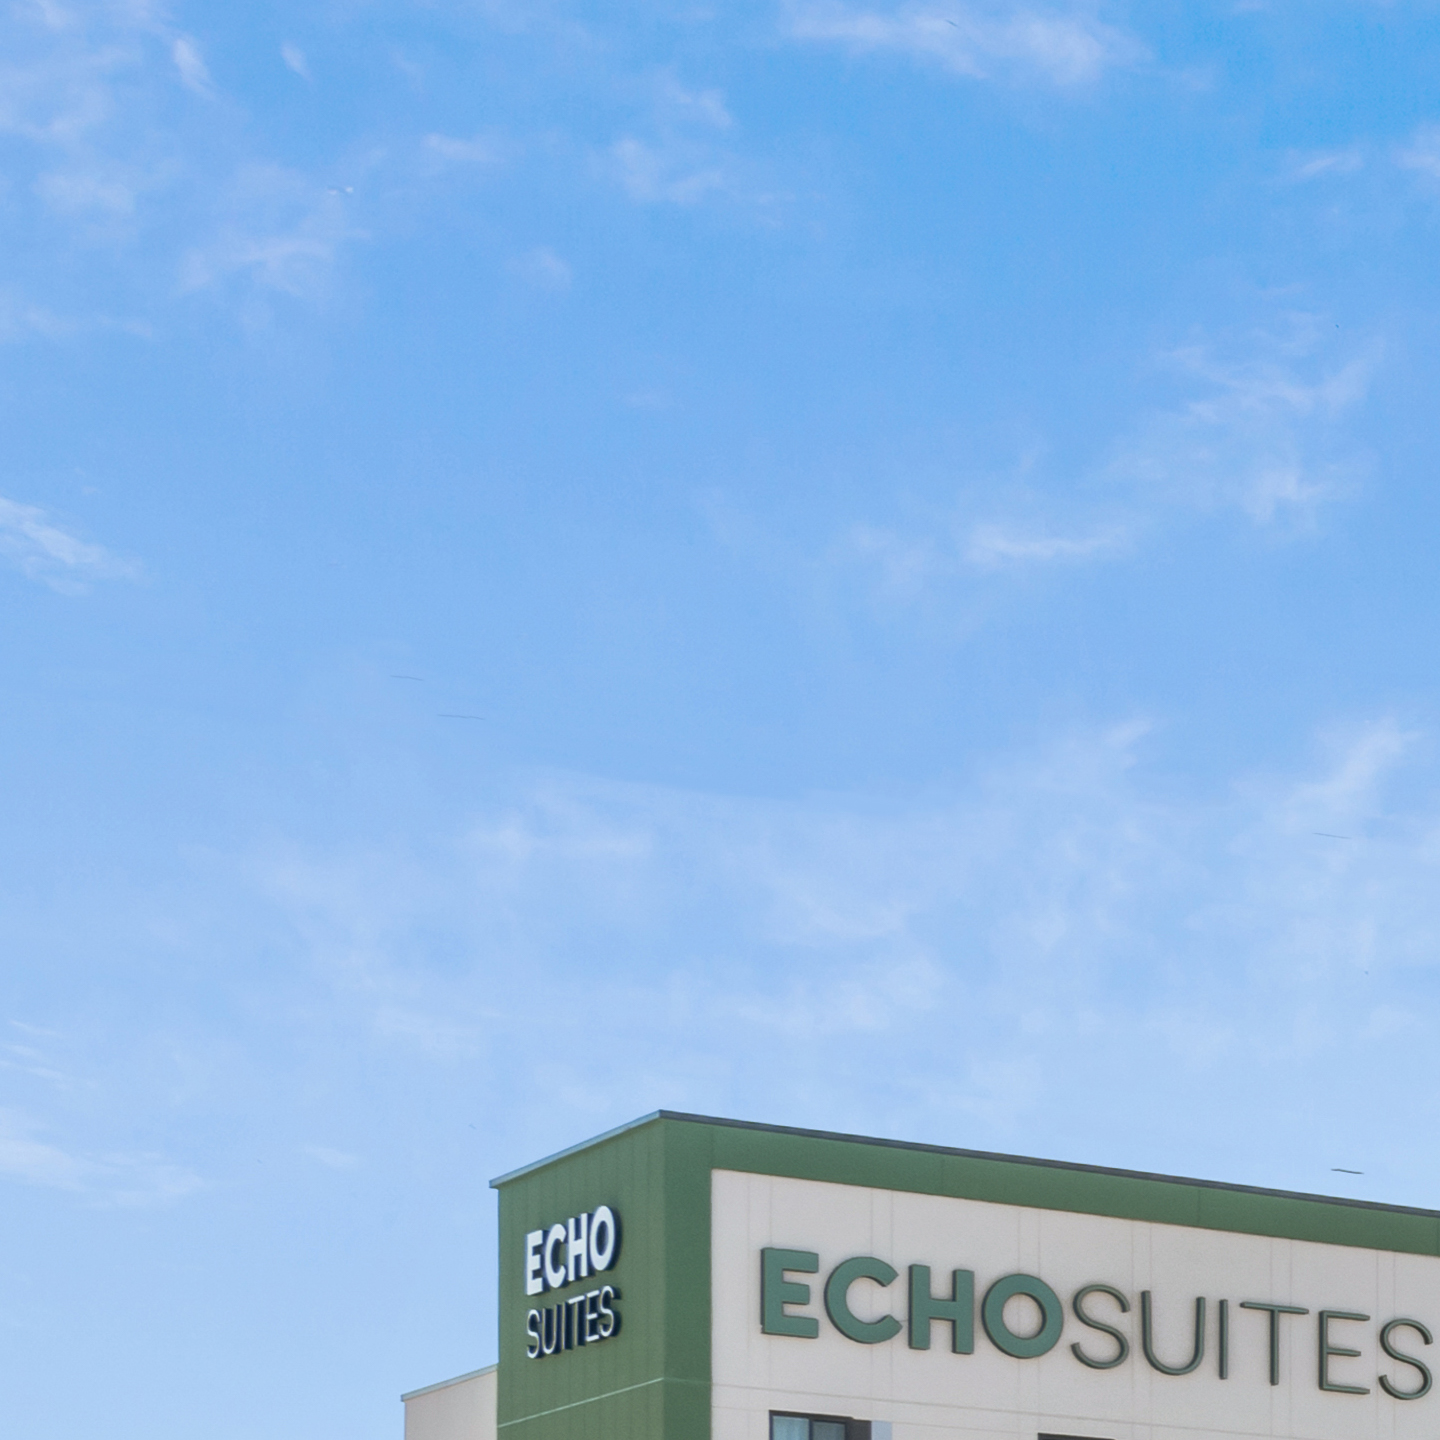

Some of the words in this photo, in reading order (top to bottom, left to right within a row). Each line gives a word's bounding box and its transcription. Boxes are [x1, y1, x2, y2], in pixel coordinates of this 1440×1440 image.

[525, 1205, 618, 1295] ECHO
[526, 1285, 617, 1358] SUITES
[760, 1246, 1434, 1401] ECHOSUITES
